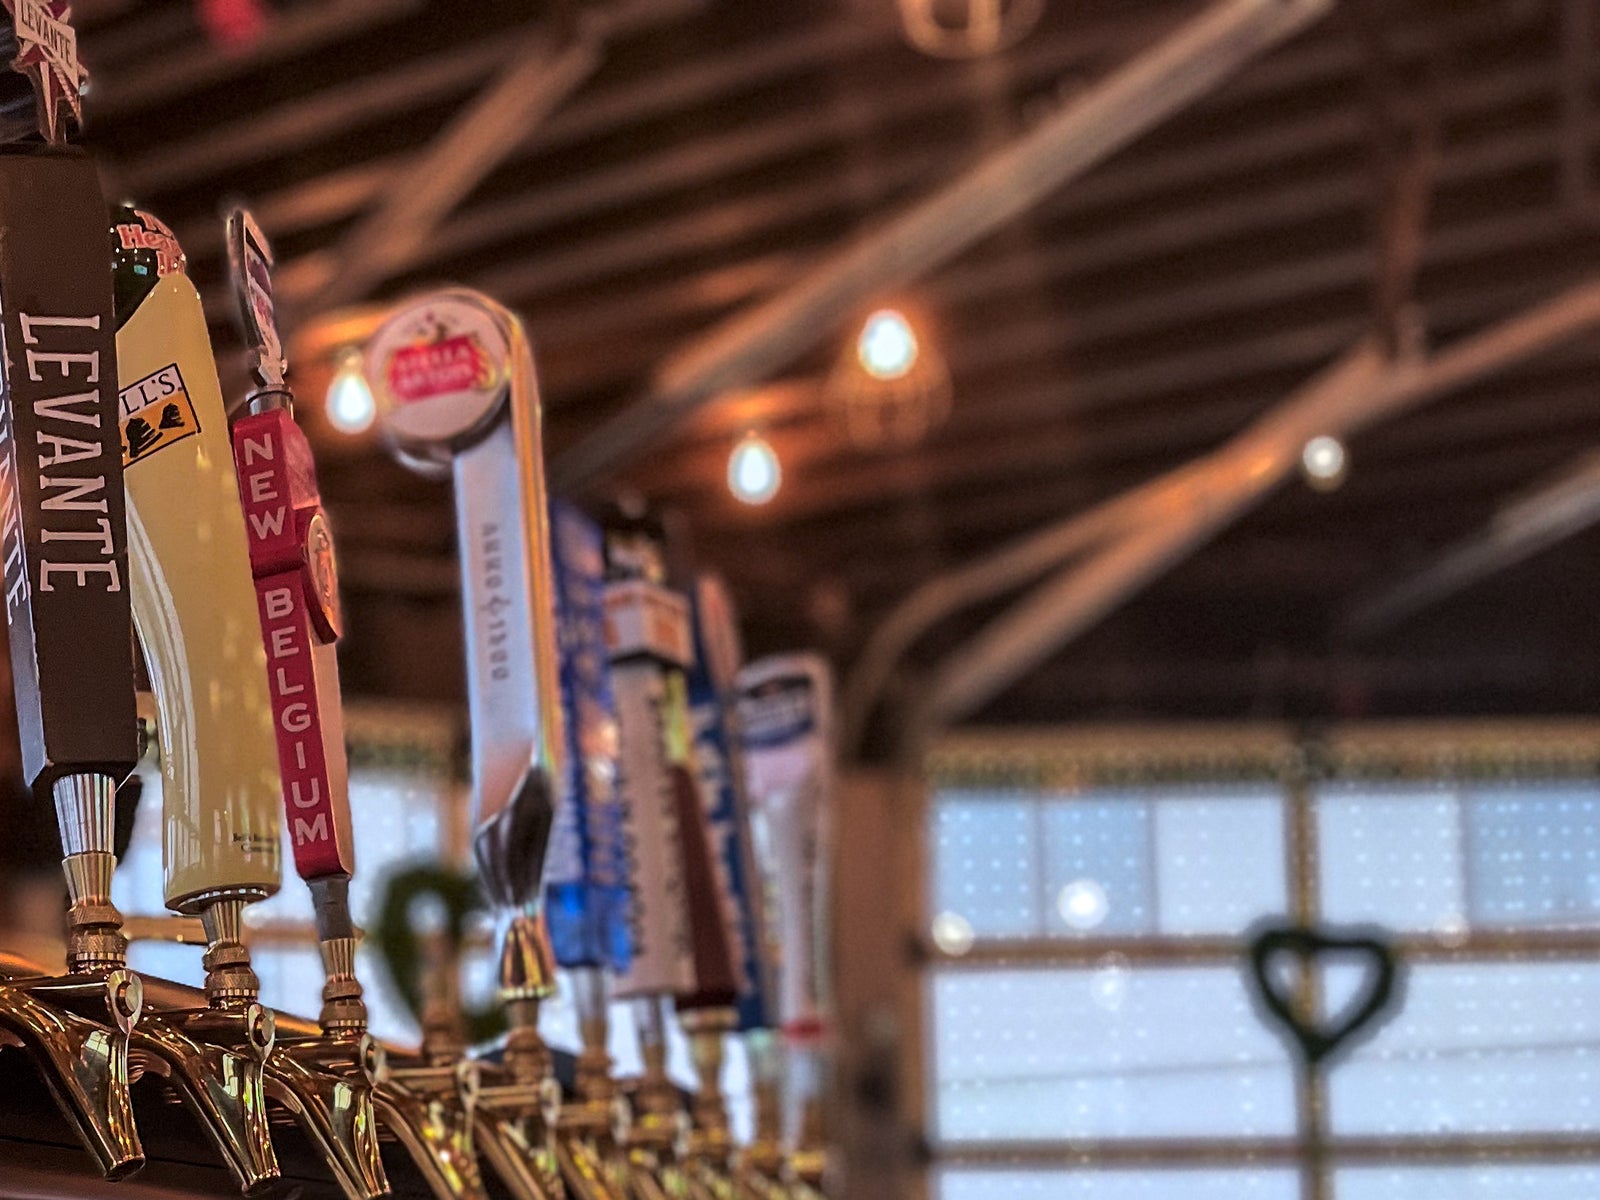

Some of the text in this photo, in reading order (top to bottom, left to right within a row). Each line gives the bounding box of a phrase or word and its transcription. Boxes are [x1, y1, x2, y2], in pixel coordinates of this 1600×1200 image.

[19, 311, 121, 593] LEVANTE
[242, 435, 329, 843] NEW BELGIUM
